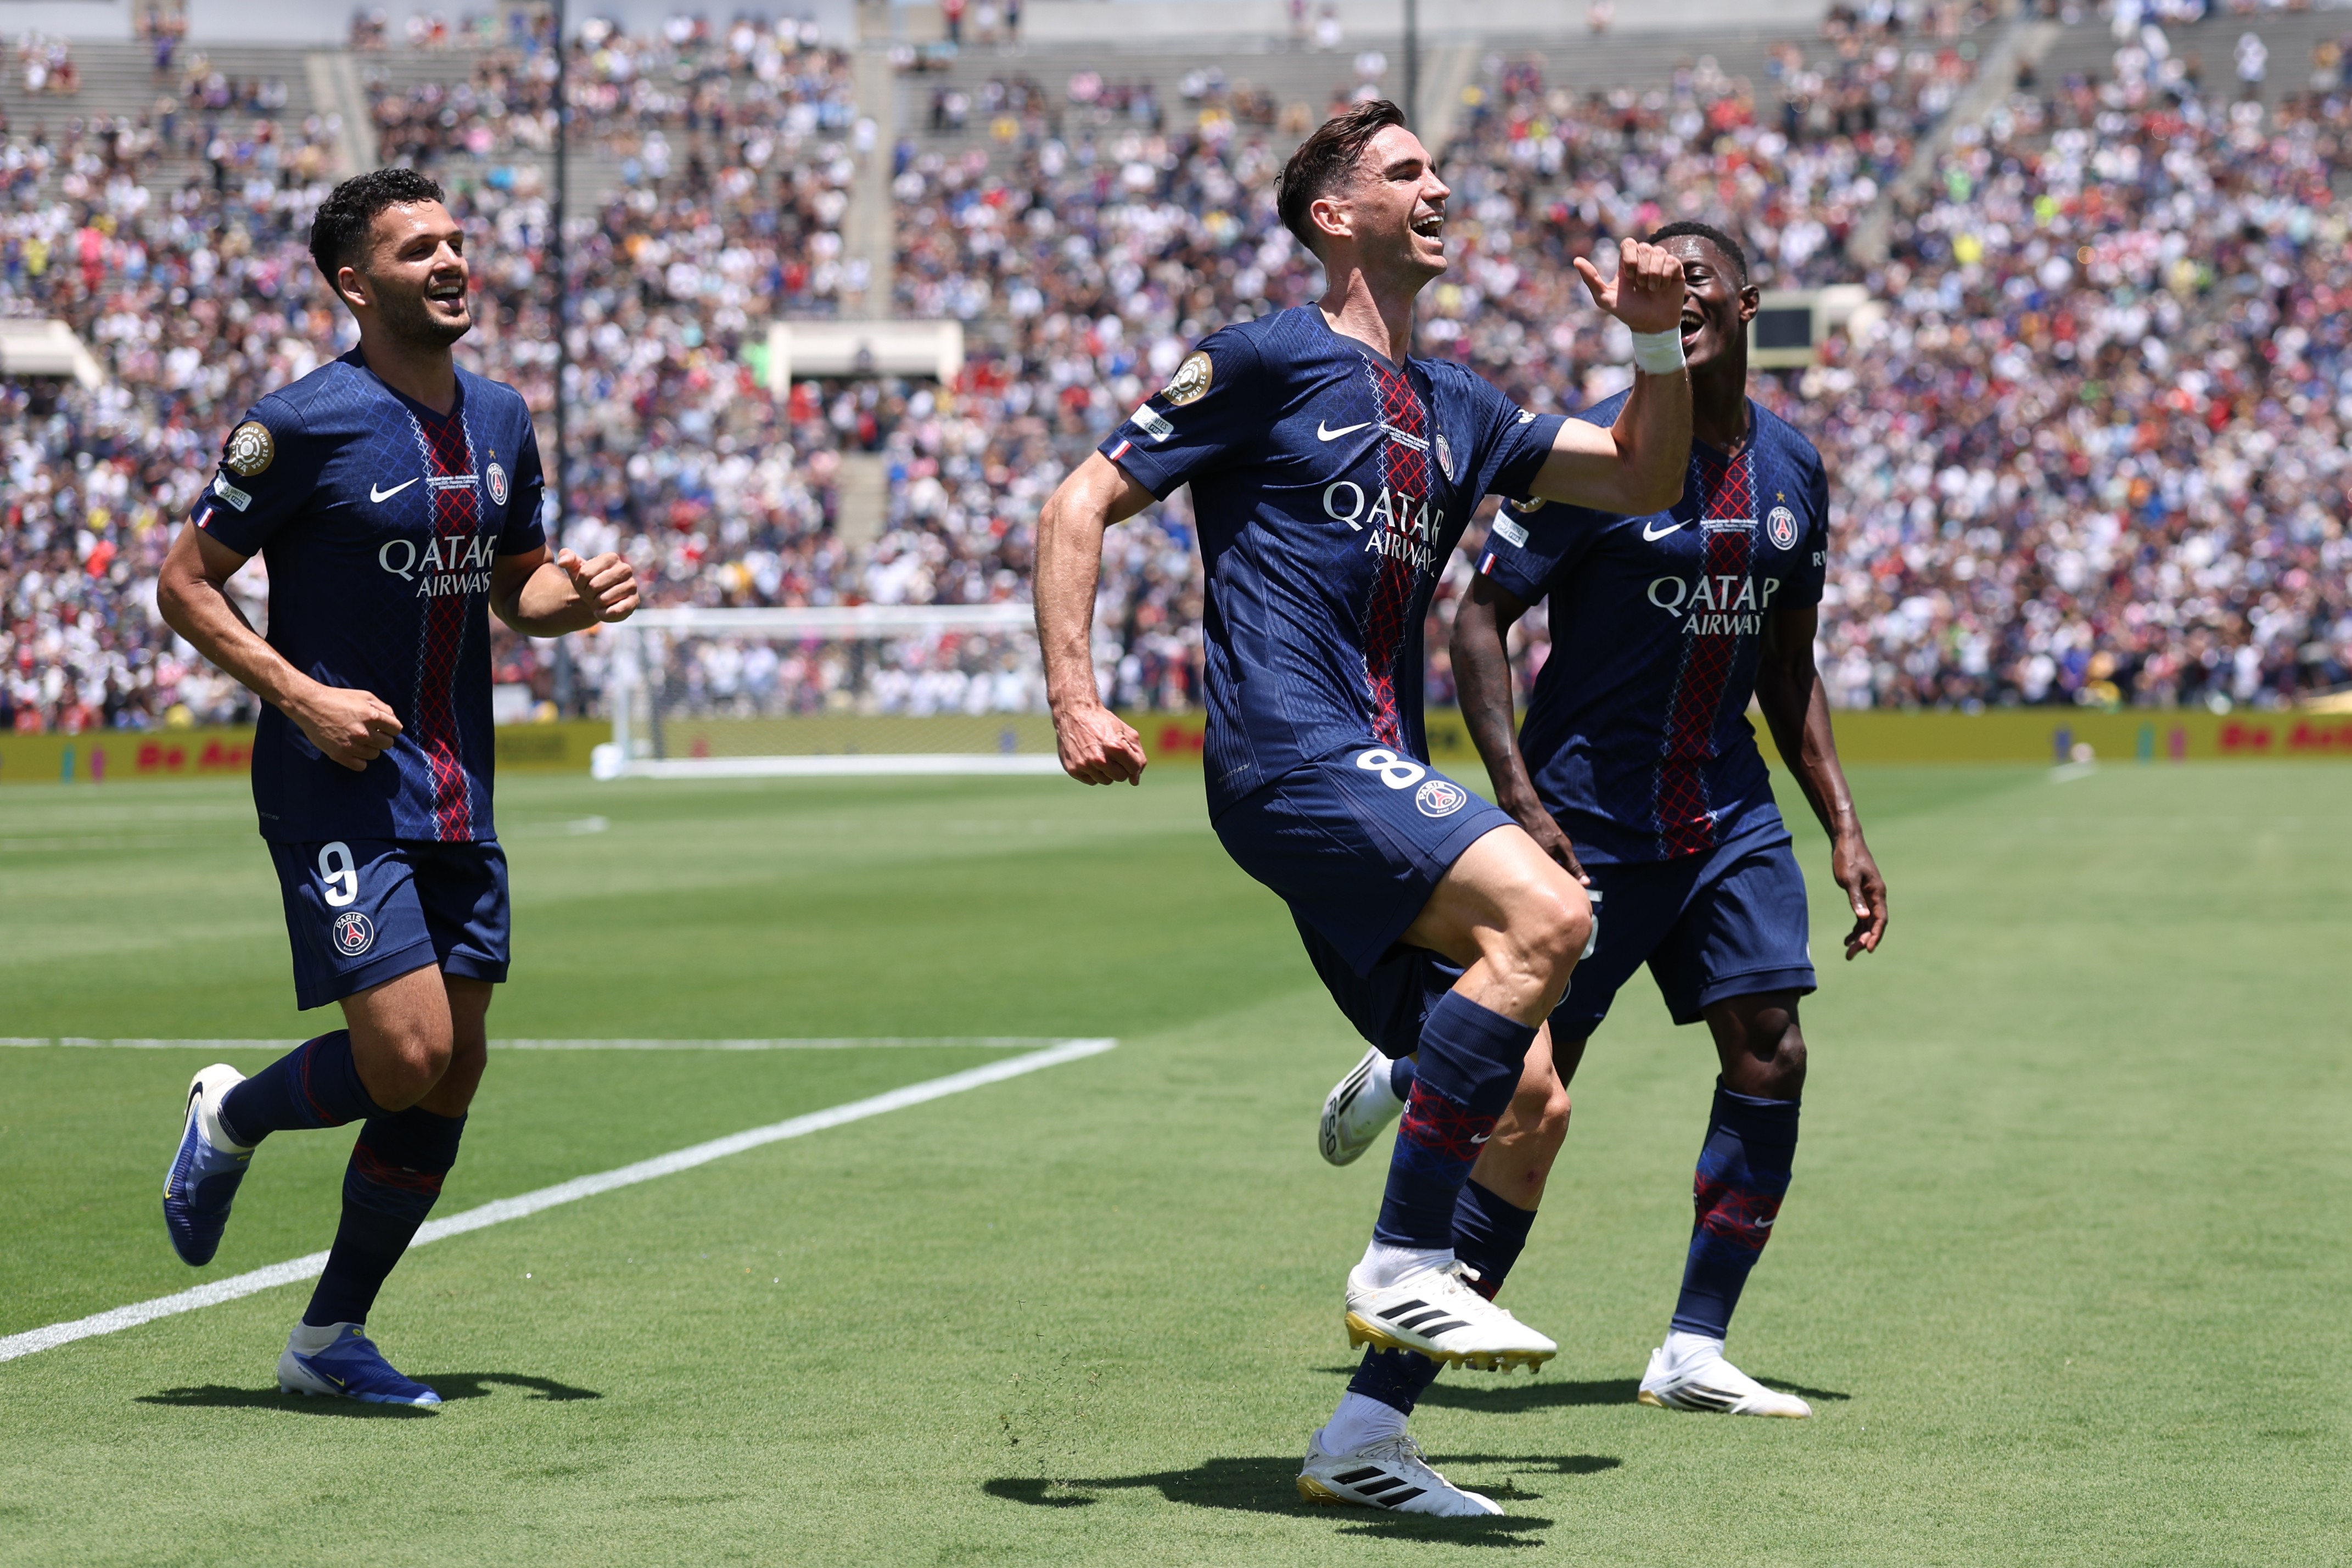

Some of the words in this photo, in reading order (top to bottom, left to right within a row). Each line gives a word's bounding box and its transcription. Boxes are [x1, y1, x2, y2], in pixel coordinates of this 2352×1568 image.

[1199, 375, 1206, 385] 25
[1188, 385, 1202, 398] USA
[239, 427, 259, 436] WORLD
[259, 433, 268, 446] CUP
[262, 449, 268, 457] 25
[251, 458, 265, 469] USA
[231, 488, 247, 500] UNITES
[1323, 481, 1444, 548] QATAR
[378, 535, 497, 581] QATAR
[1364, 529, 1437, 578] AIRWAY
[1681, 613, 1762, 636] AIRWAY
[1356, 749, 1426, 789] 8
[1418, 782, 1445, 800] PARIS
[318, 841, 358, 907] 9
[336, 914, 362, 929] PARIS
